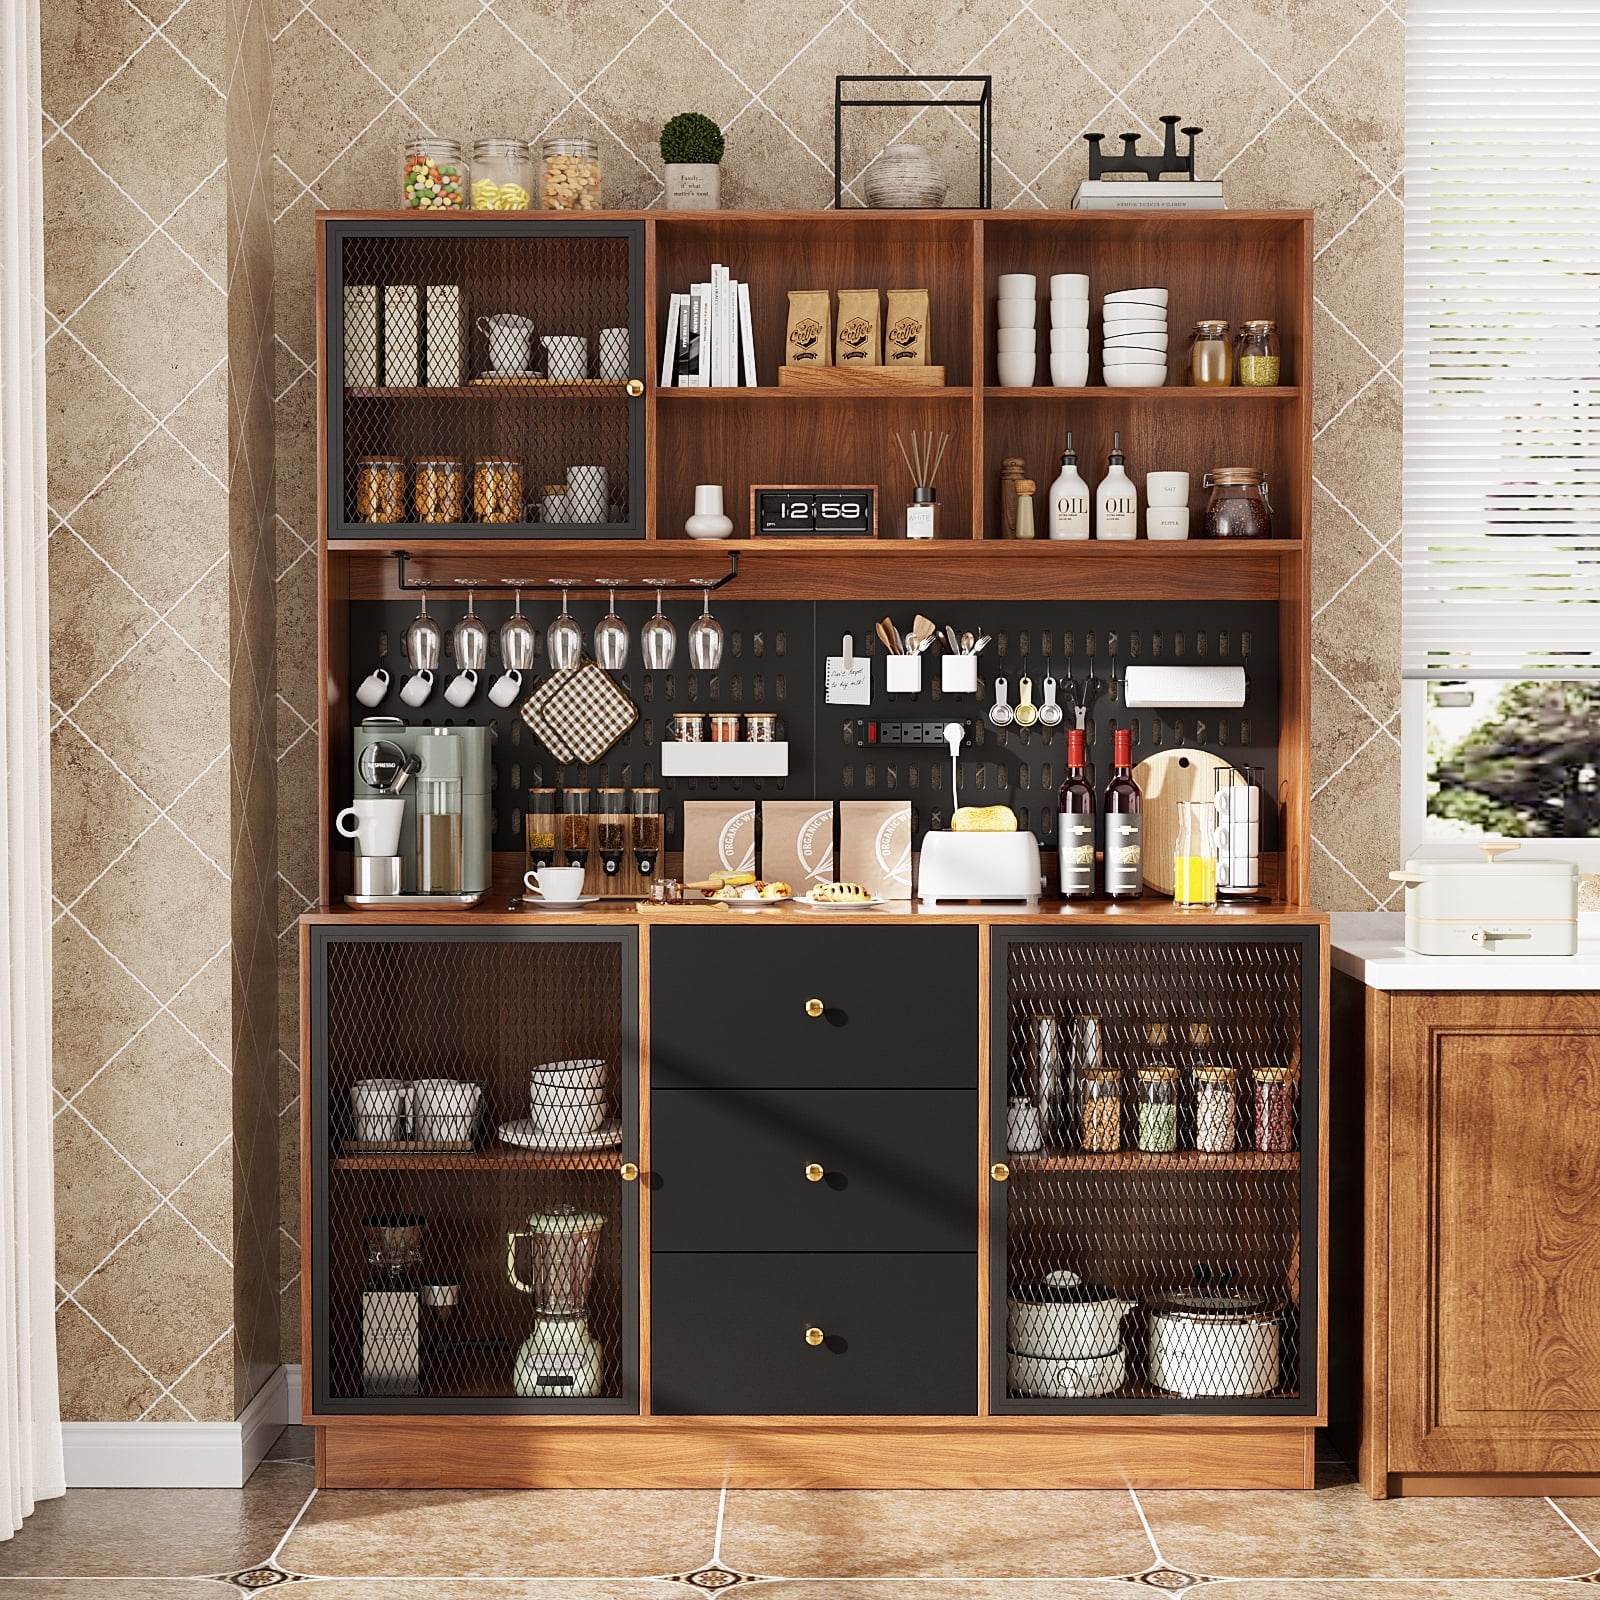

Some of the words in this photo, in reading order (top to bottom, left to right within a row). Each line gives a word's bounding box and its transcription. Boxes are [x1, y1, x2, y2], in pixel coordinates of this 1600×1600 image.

[1058, 498, 1087, 513] OIL
[1105, 498, 1135, 513] OIL
[725, 819, 744, 856] ORGANIC
[803, 819, 822, 856] ORGANIC
[881, 820, 900, 856] ORGANIC
